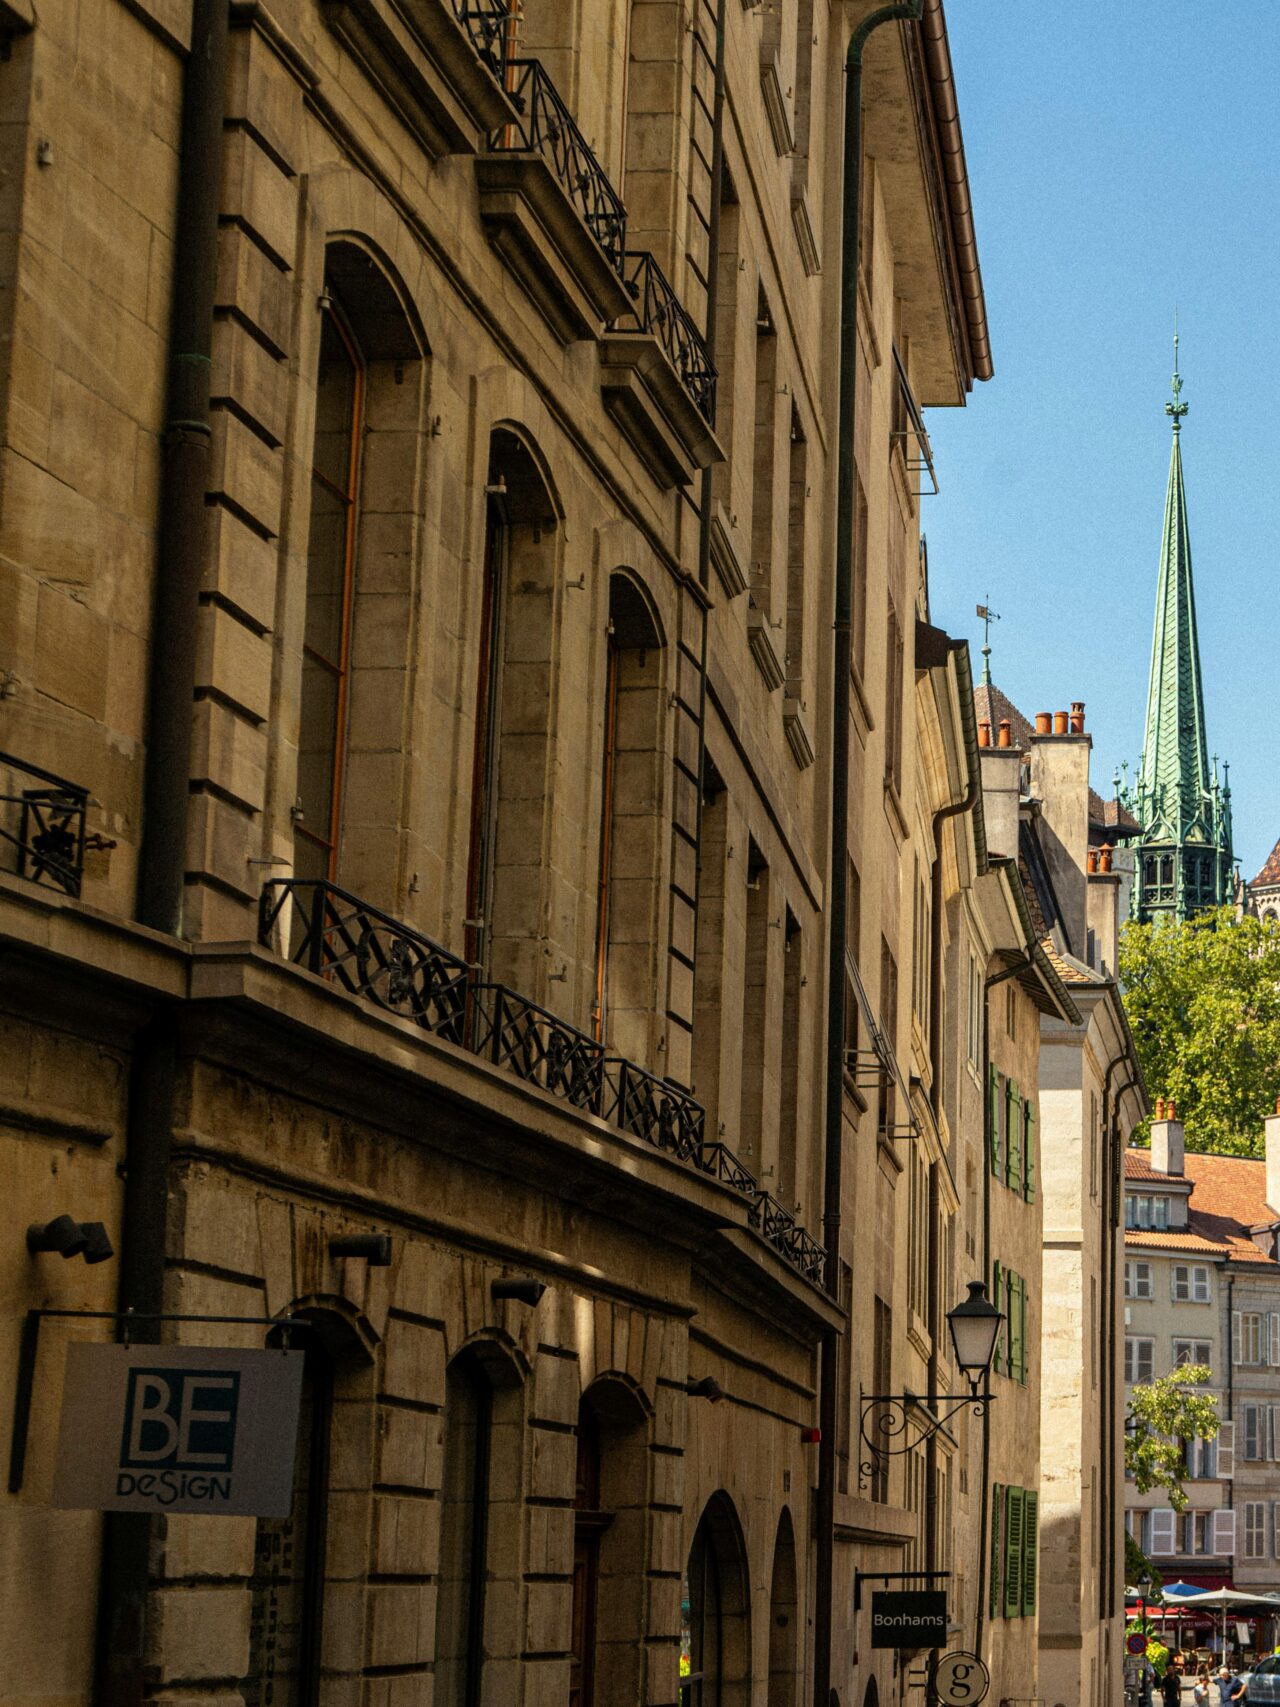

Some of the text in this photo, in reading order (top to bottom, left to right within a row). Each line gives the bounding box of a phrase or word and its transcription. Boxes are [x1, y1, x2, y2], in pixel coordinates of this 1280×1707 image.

[128, 1373, 234, 1465] BE
[874, 1613, 944, 1626] Bonhams
[950, 1663, 975, 1698] g
